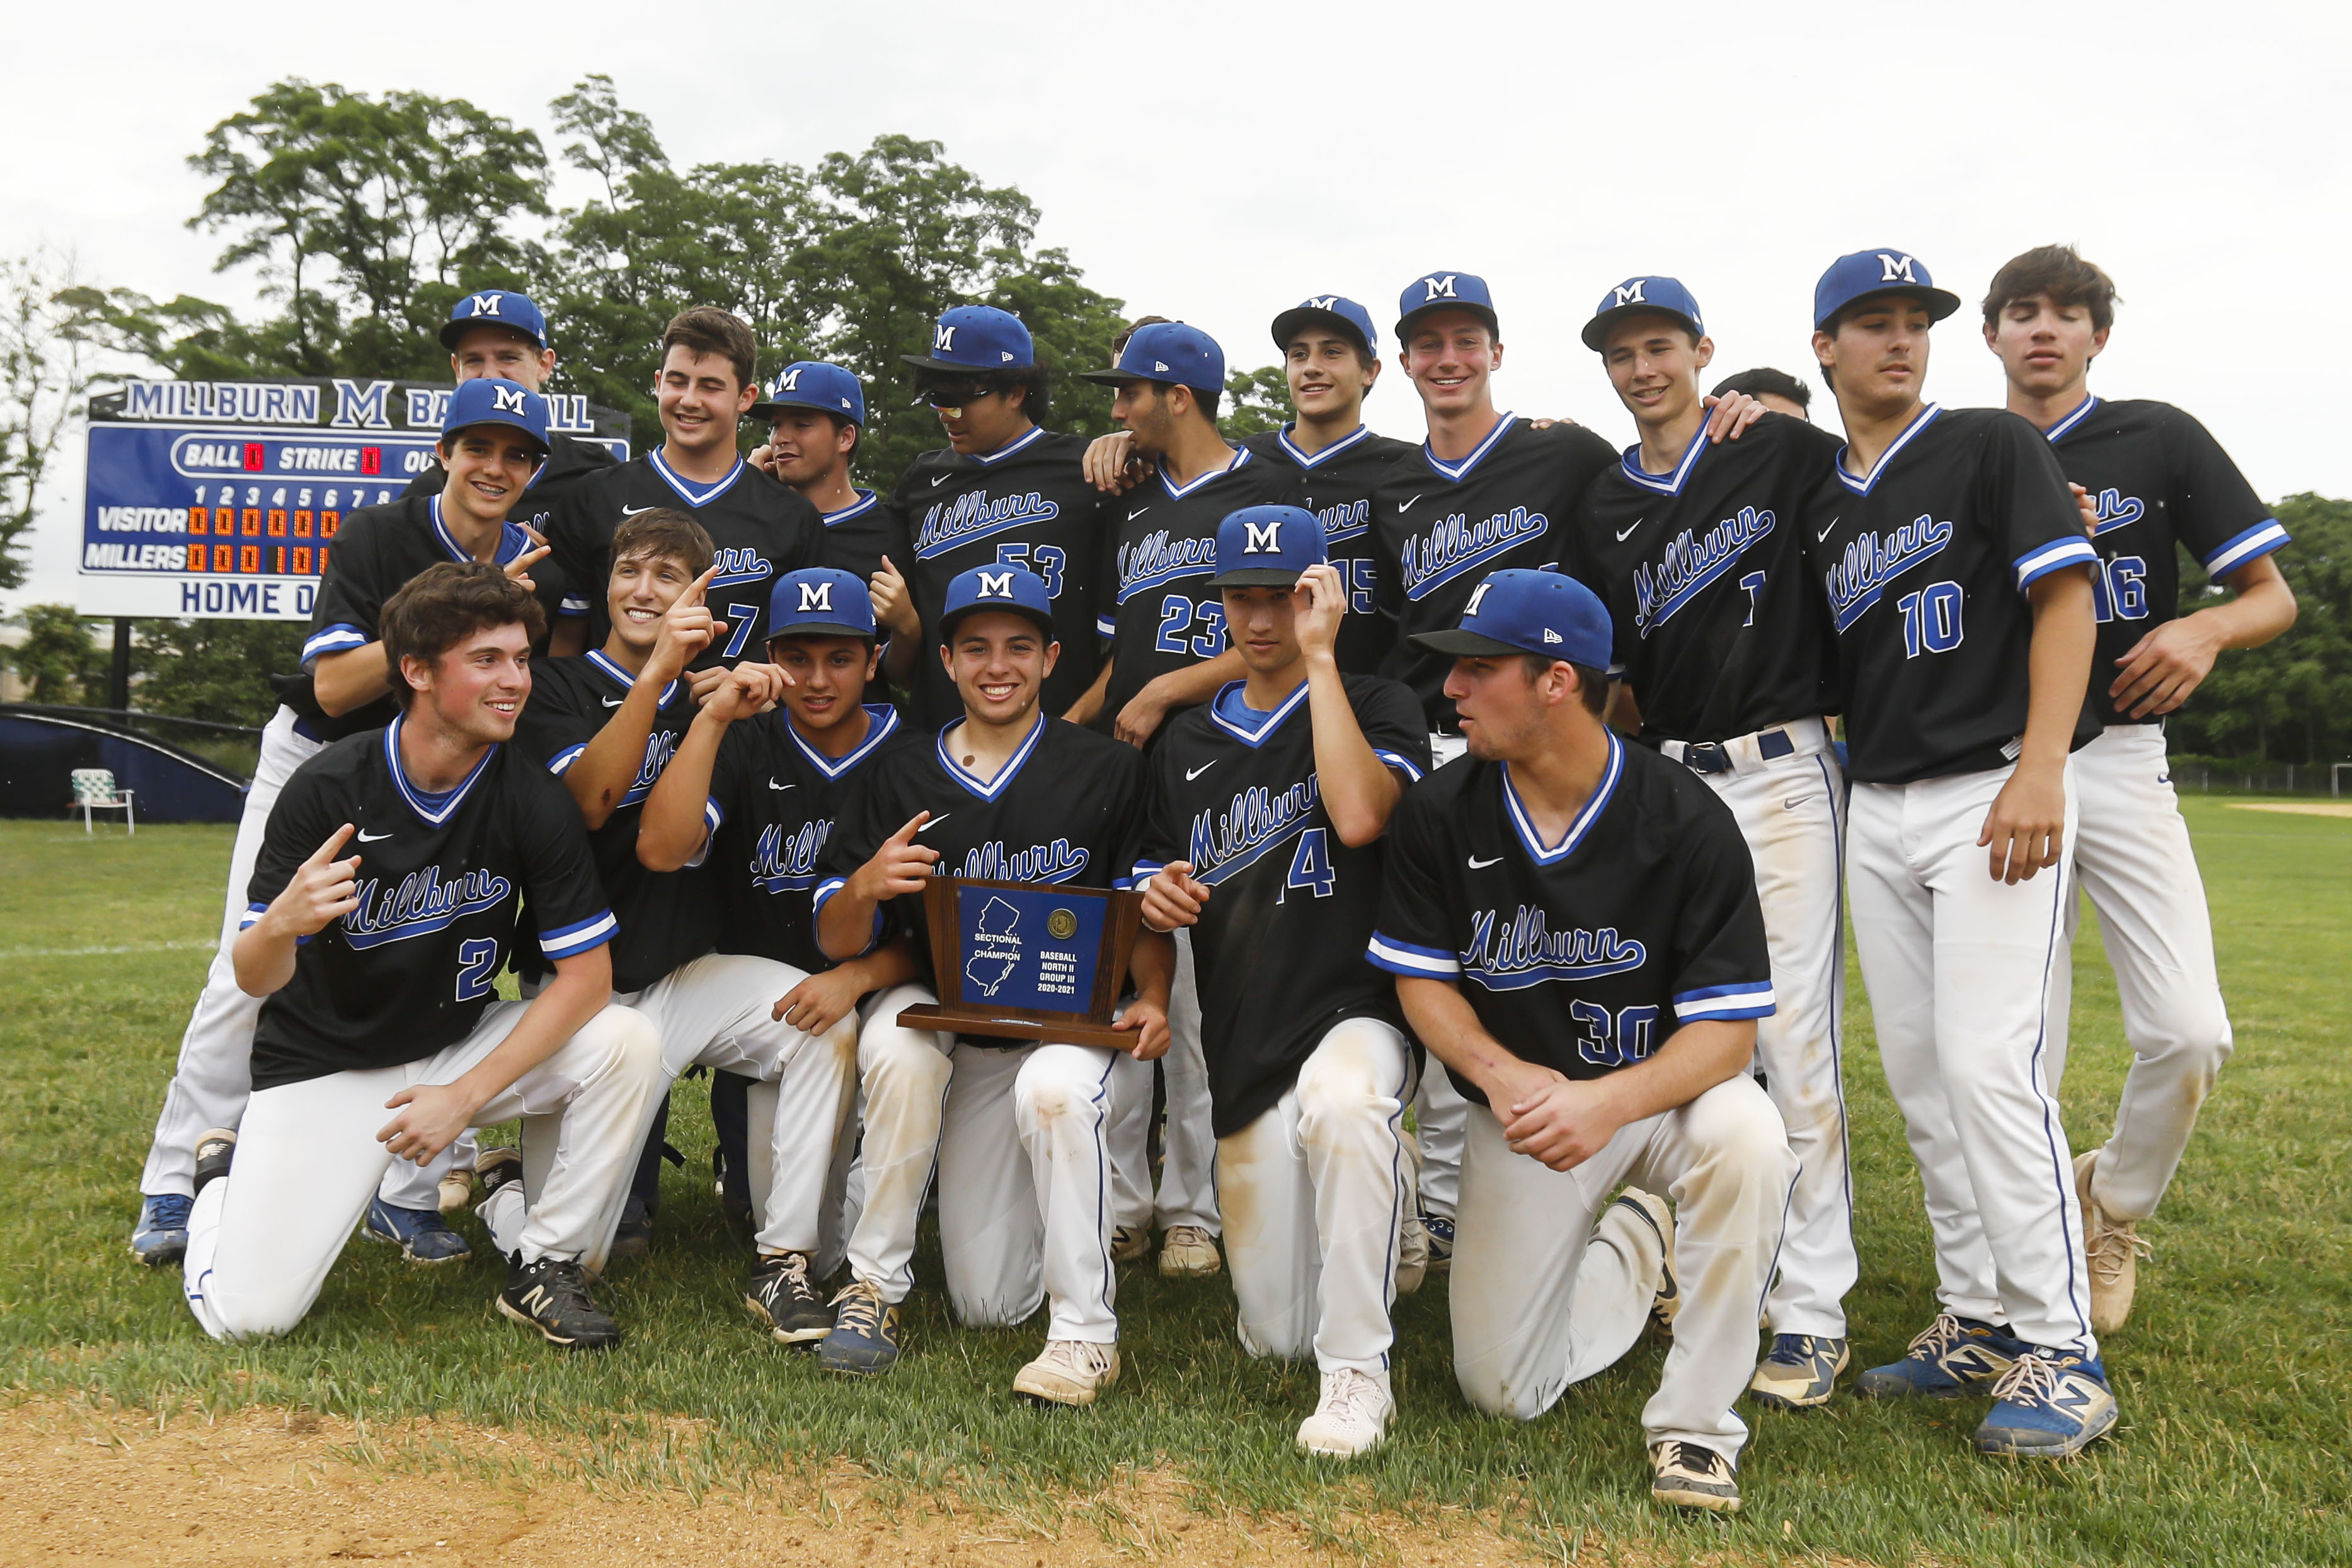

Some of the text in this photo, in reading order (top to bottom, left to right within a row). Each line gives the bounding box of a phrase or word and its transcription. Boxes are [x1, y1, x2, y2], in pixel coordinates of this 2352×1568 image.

[1877, 253, 1917, 283] M
[1425, 275, 1457, 301] M
[1614, 280, 1646, 307] M
[471, 295, 502, 317] M
[935, 324, 956, 351] M
[776, 369, 802, 393] M
[116, 381, 321, 425] MILLBURN
[330, 379, 395, 429] M
[493, 385, 526, 416] M
[184, 444, 242, 468] BALL
[278, 447, 359, 471] STRIKE
[195, 485, 206, 504] 1
[219, 486, 235, 505] 2
[246, 487, 261, 506] 3
[272, 488, 287, 506] 4
[298, 488, 313, 507] 5
[324, 489, 338, 508] 6
[352, 489, 365, 508] 7
[98, 506, 188, 533] VISITOR
[914, 490, 1058, 552] Millburn
[1243, 522, 1283, 554] M
[1401, 505, 1548, 591] Millburn
[84, 544, 188, 570] MILLERS
[996, 542, 1066, 600] 53
[181, 582, 282, 614] HOME
[797, 582, 833, 612] M
[976, 571, 1015, 599] M
[722, 603, 759, 658] 7
[1156, 594, 1227, 658] 23
[1896, 581, 1964, 660] 10
[1287, 828, 1336, 898] 4
[341, 865, 510, 934] Millburn
[975, 933, 1022, 944] SECTIONAL
[1459, 905, 1646, 974] Millburn
[456, 936, 498, 1002] 2
[975, 949, 1021, 961] CHAMPION
[1040, 951, 1077, 963] BASEBALL
[1041, 961, 1074, 973] NORTH II
[1040, 972, 1075, 983] GROUP III
[1569, 999, 1660, 1067] 30
